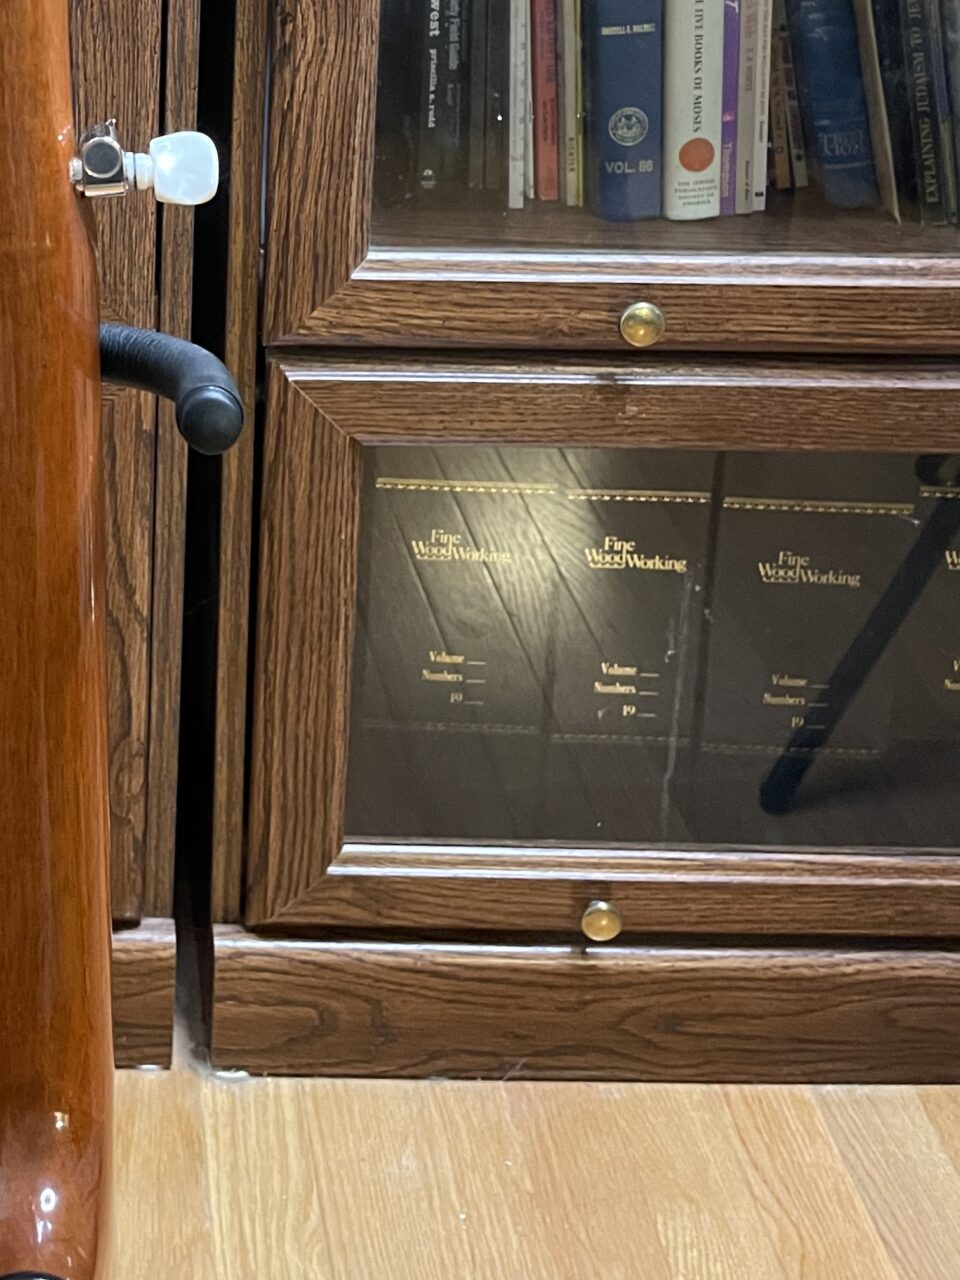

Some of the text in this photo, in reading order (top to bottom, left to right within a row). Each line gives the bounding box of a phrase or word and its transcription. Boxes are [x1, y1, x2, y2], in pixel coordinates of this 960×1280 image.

[694, 8, 704, 30] FIVE
[911, 26, 923, 46] TO
[693, 33, 704, 74] BOOKS
[693, 76, 703, 90] OF
[913, 52, 931, 112] JUDAISM
[693, 94, 703, 133] MOSES
[604, 160, 636, 174] VOL.
[918, 117, 938, 203] EXPLAINING
[431, 529, 460, 546] Fine
[605, 536, 635, 554] Fine
[778, 551, 809, 567] Fine
[600, 662, 637, 676] Volume
[594, 681, 636, 695] Numbers
[622, 703, 635, 717] 19
